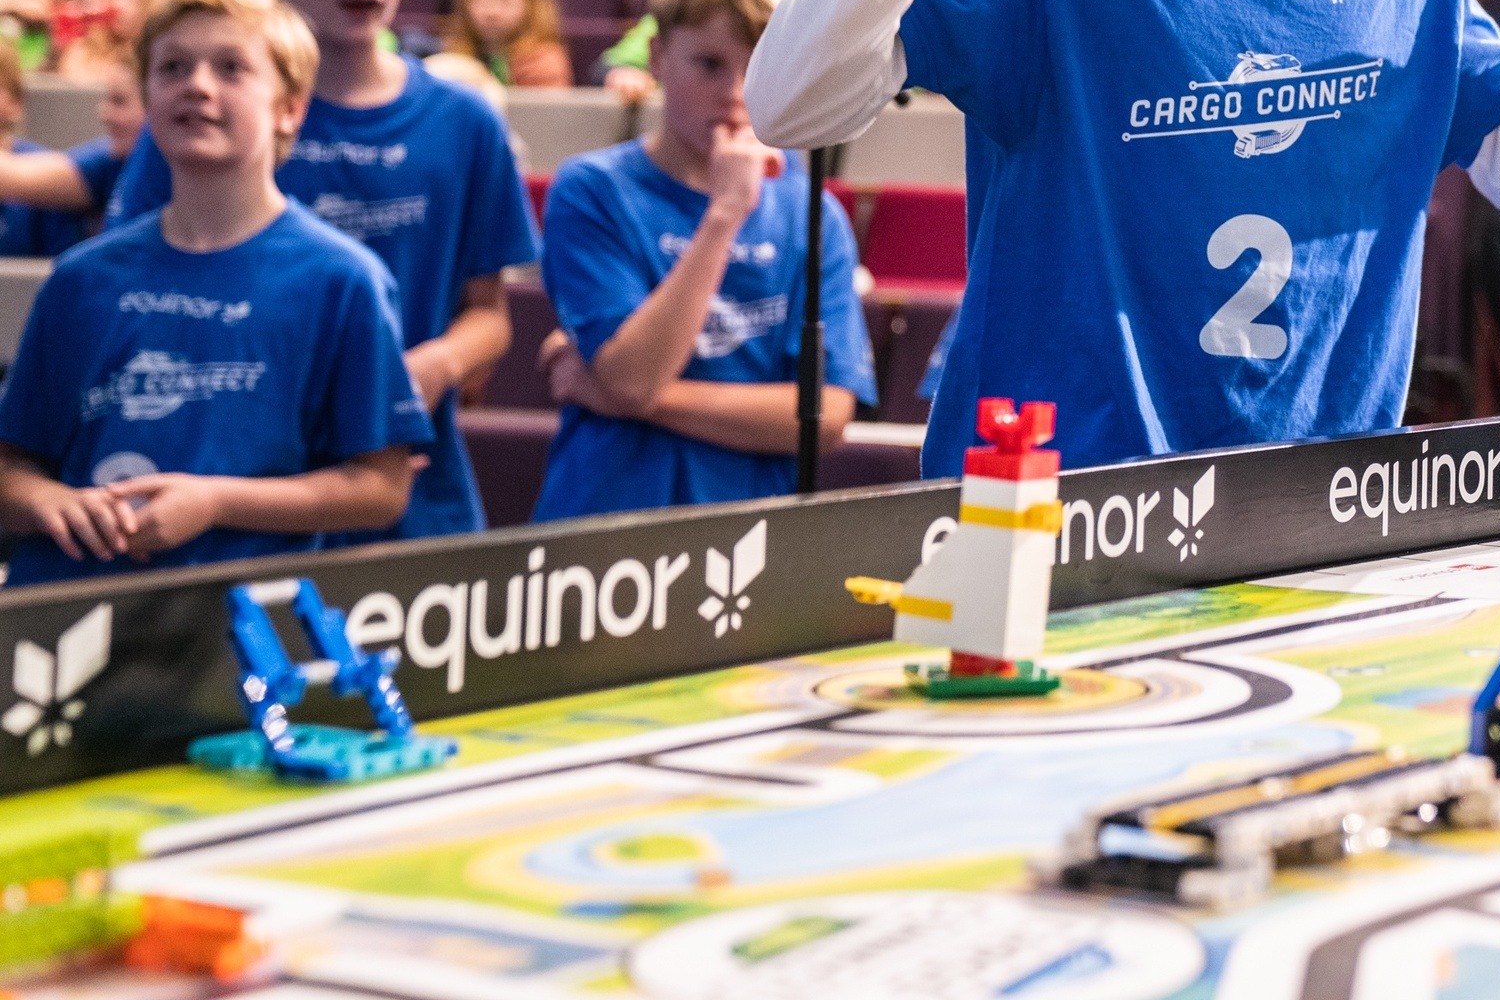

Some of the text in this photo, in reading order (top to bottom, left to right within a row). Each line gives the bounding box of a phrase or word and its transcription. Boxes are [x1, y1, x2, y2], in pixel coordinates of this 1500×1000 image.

[1129, 70, 1382, 128] CARGO CONNECT
[1198, 213, 1294, 360] 2
[921, 490, 1161, 567] enor
[344, 545, 691, 694] equinor
